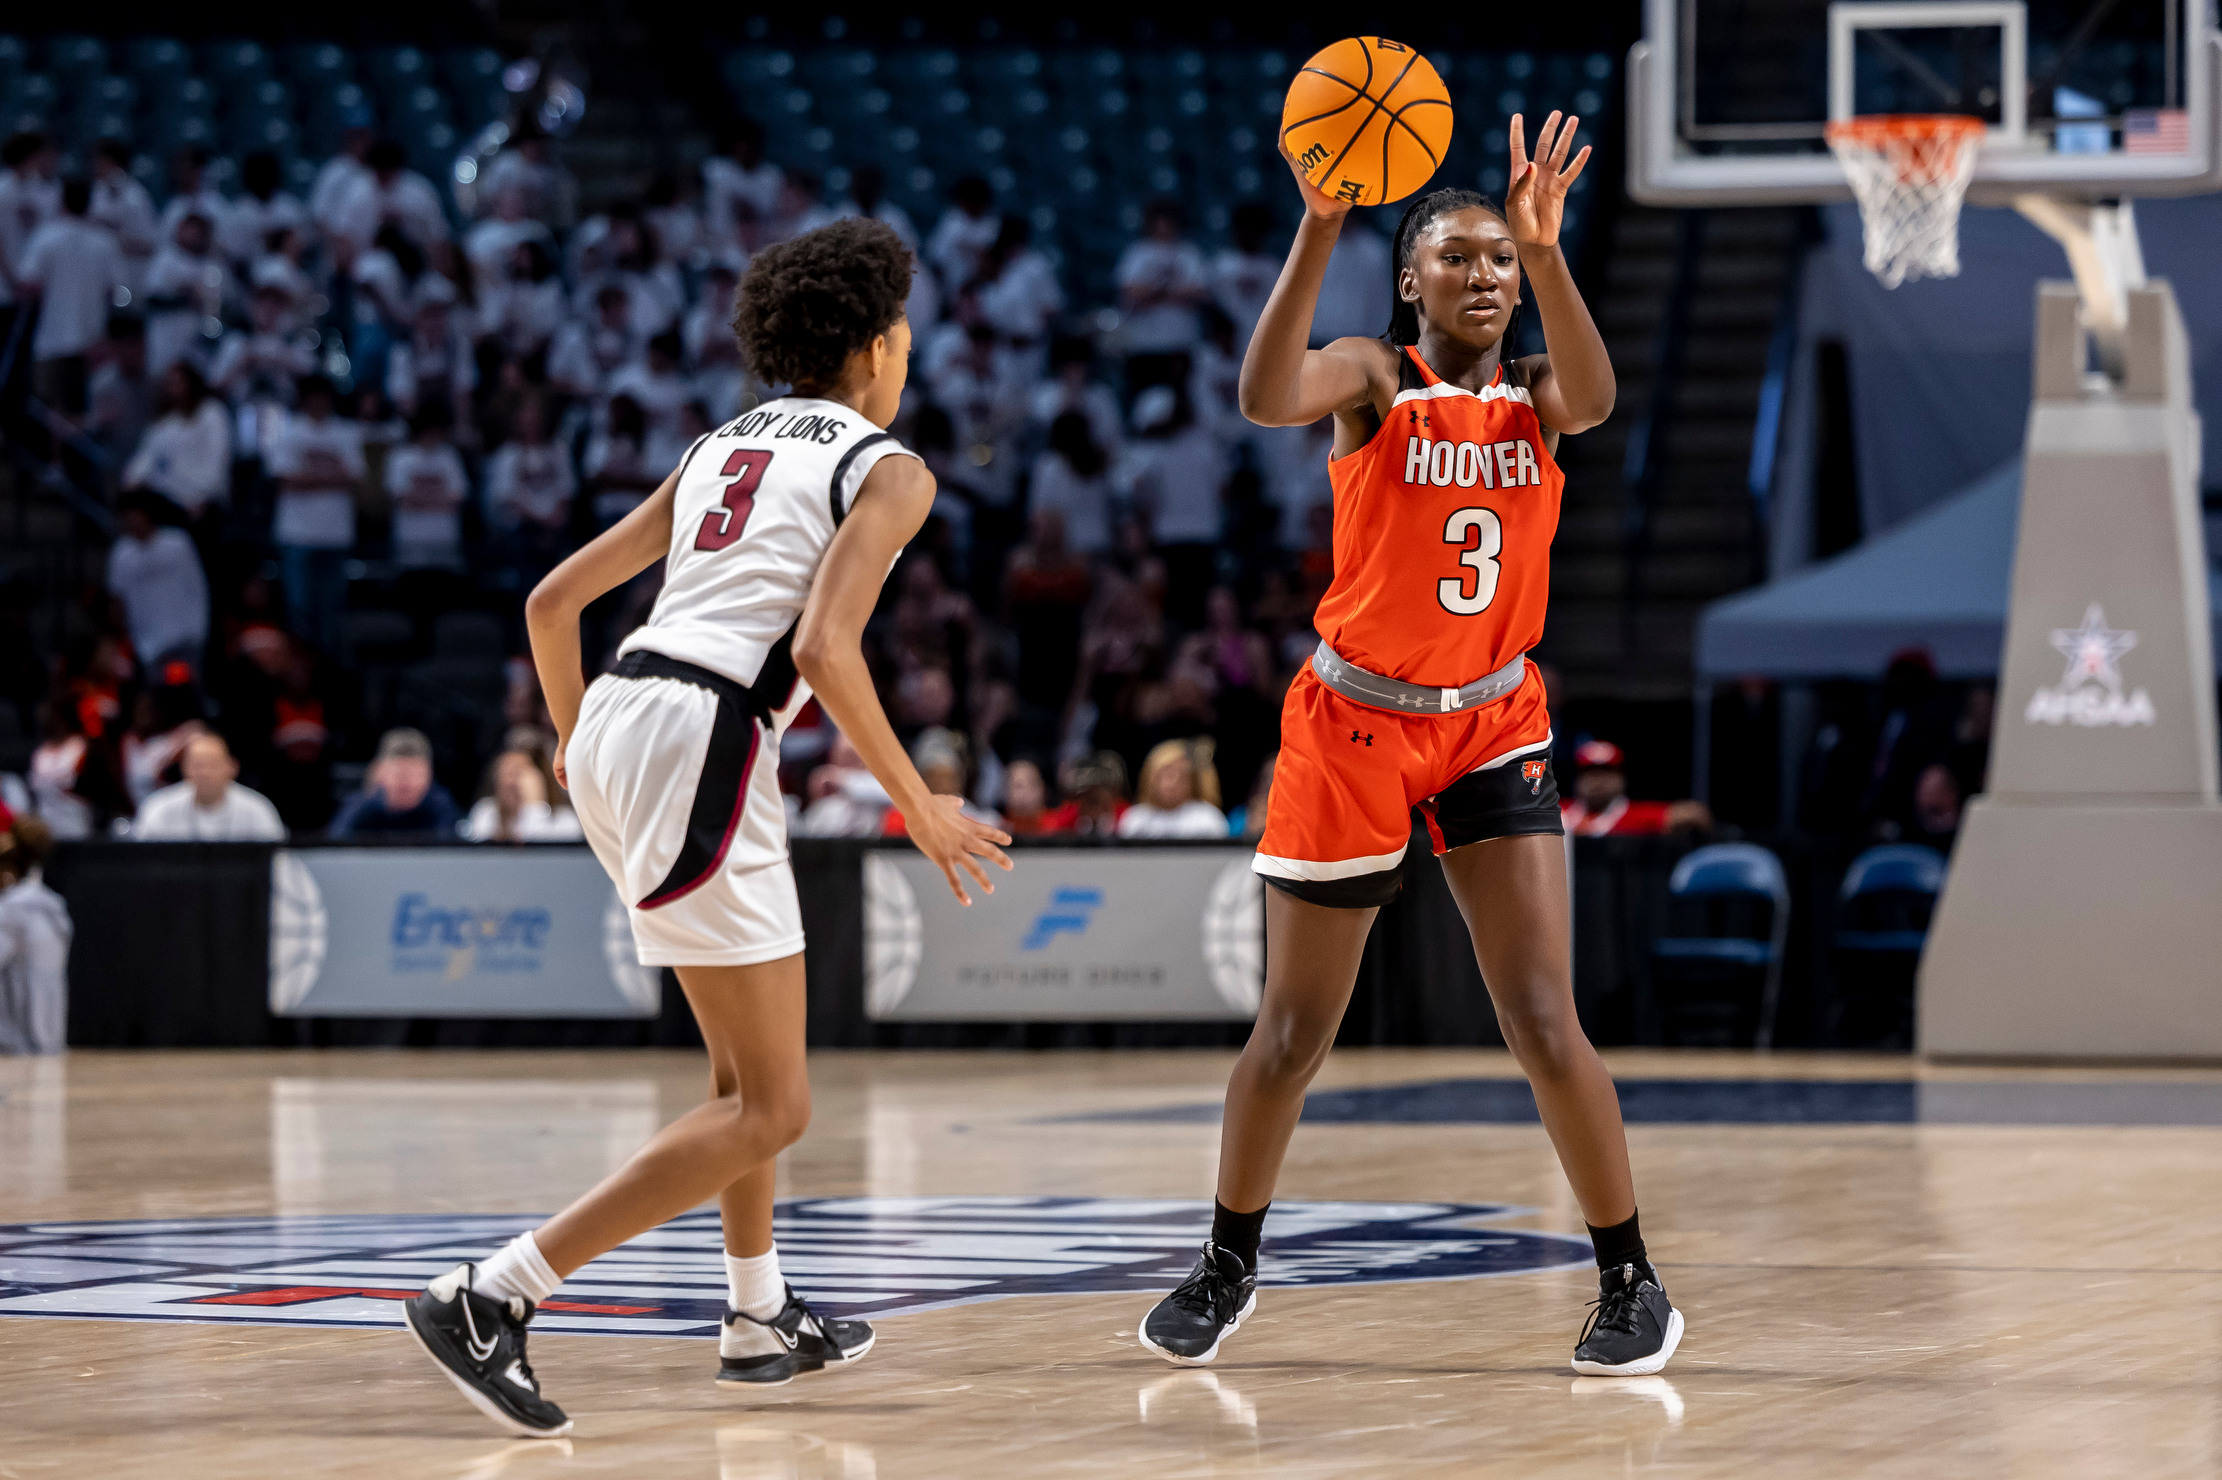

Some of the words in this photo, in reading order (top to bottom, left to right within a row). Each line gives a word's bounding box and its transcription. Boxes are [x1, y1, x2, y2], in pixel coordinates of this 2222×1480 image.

[1296, 142, 1331, 175] son
[718, 411, 783, 438] LADY
[775, 415, 847, 444] LIONS
[1404, 436, 1542, 490] HOOVER
[694, 449, 774, 551] 3
[1437, 506, 1503, 616] 3
